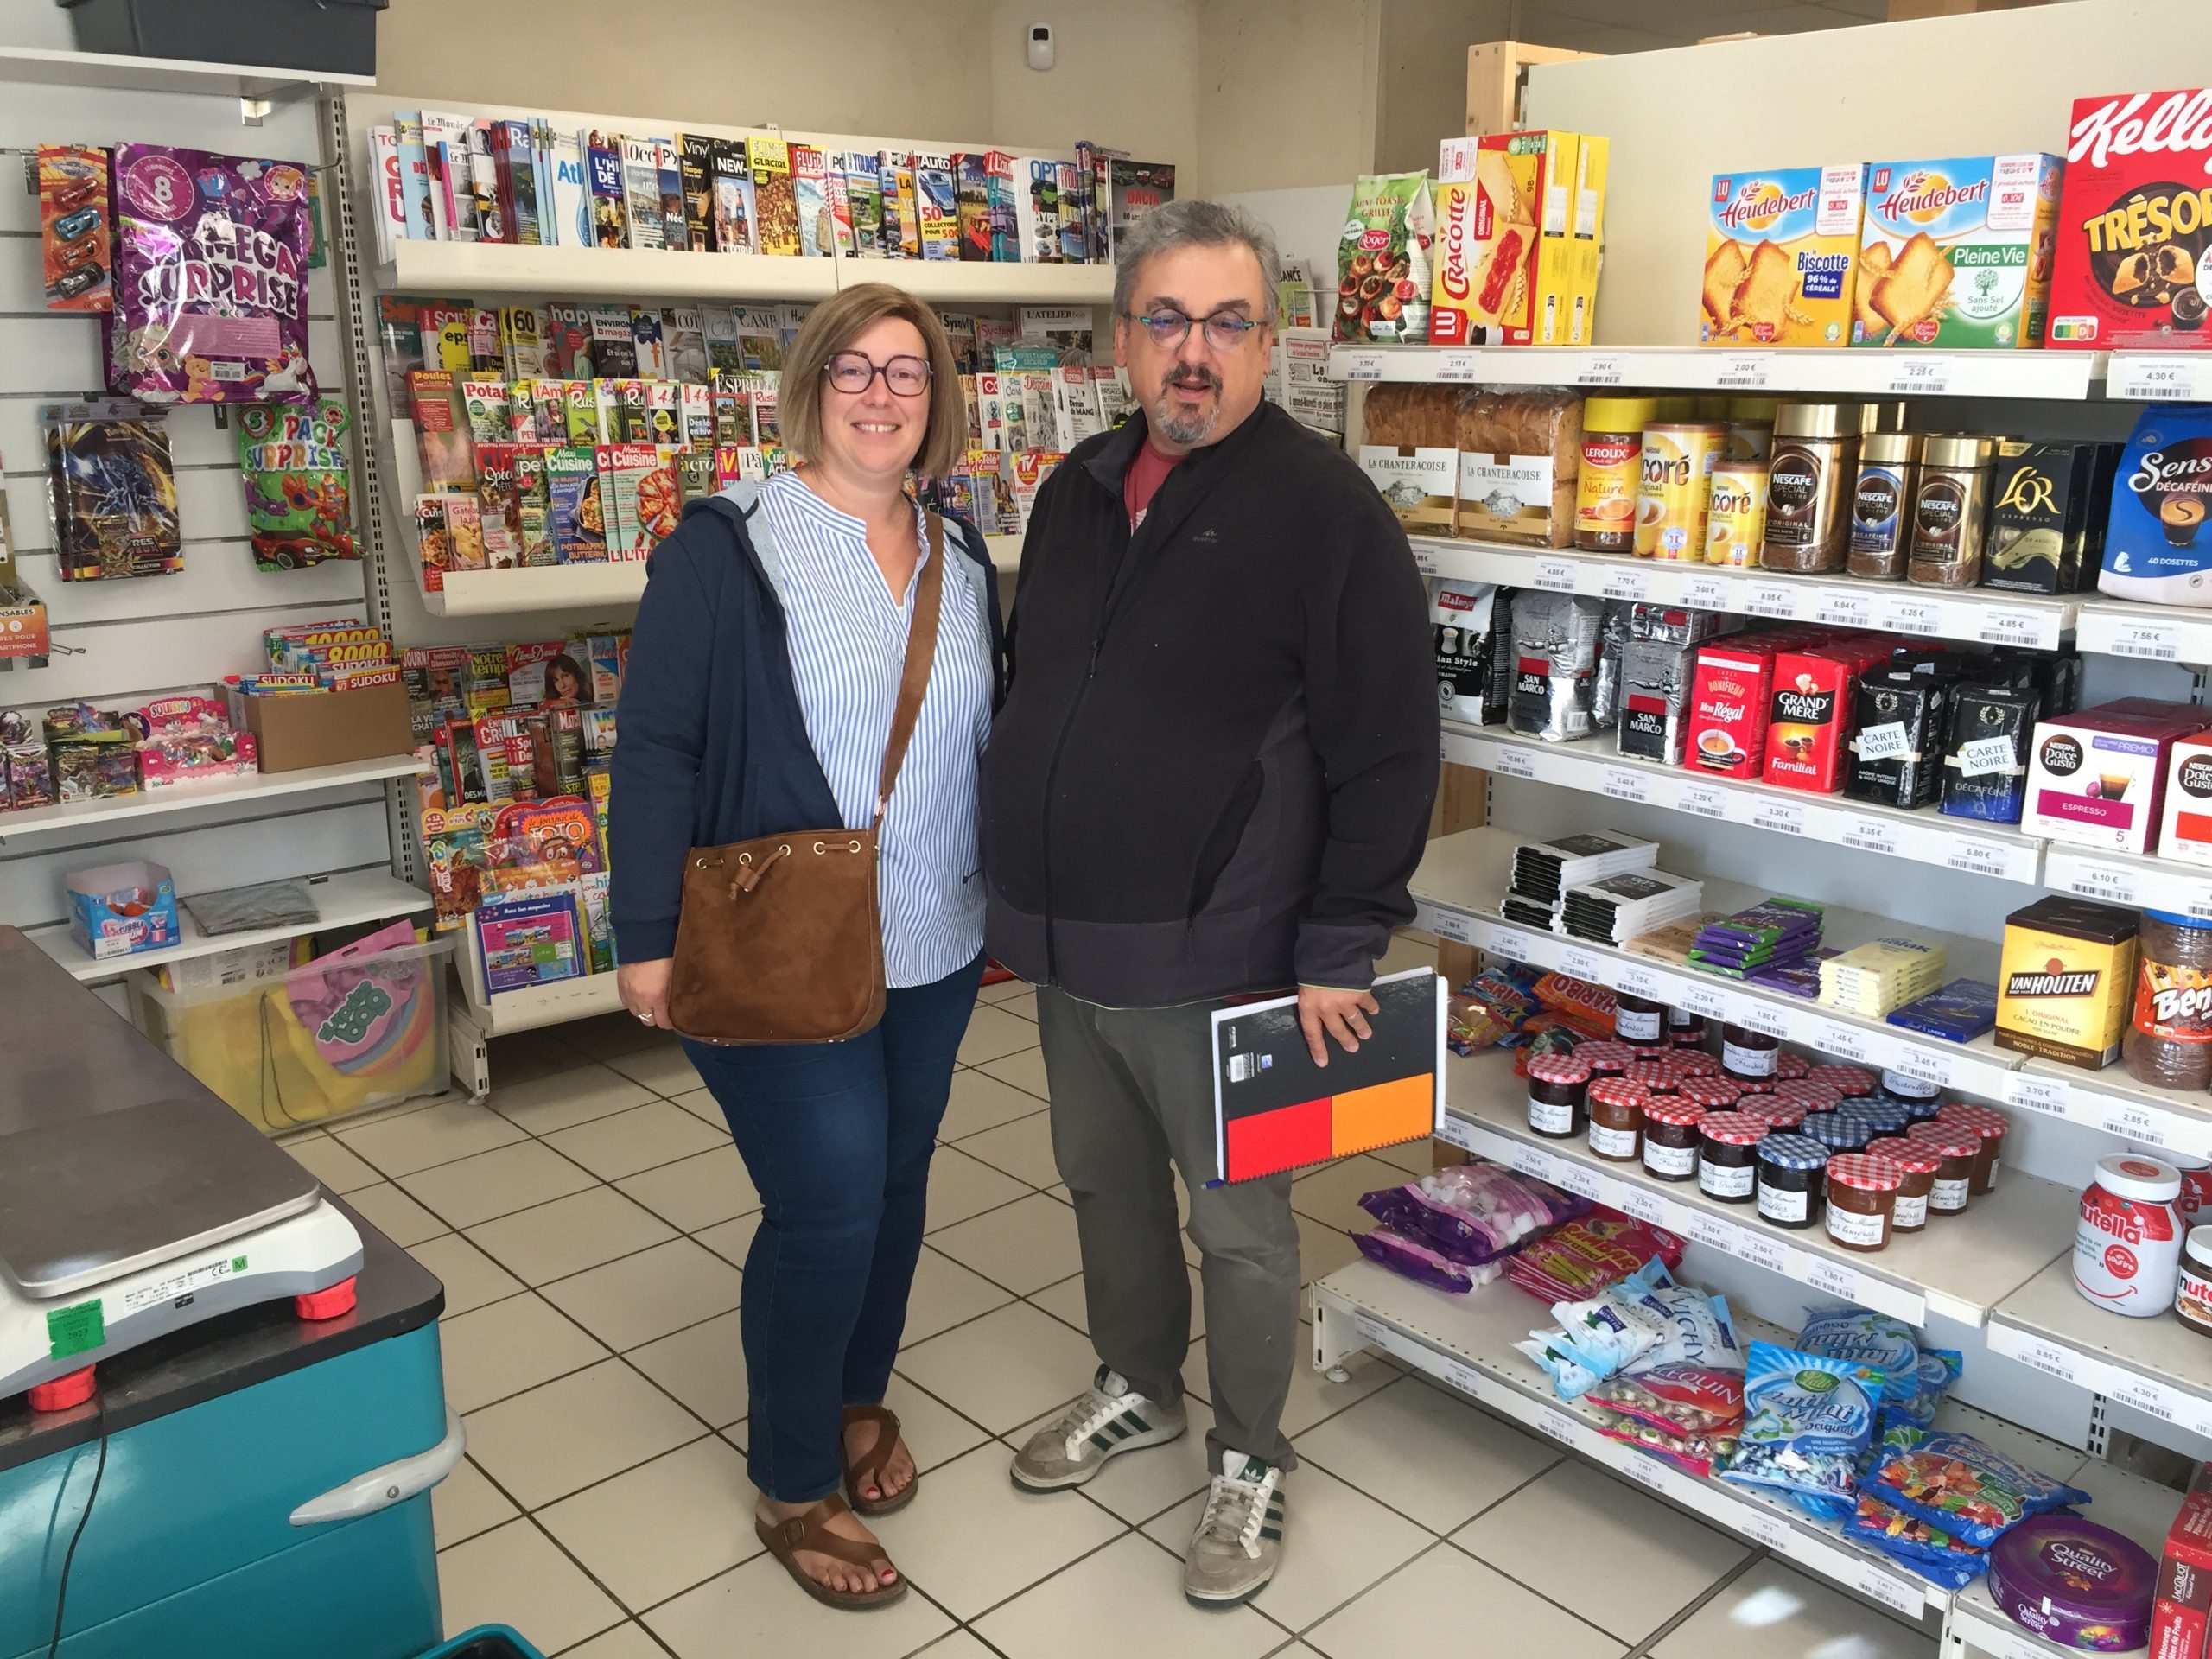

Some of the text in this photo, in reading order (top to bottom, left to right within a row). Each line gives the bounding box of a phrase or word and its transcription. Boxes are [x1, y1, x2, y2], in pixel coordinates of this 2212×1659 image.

[1875, 171, 1889, 188] LU
[154, 176, 173, 201] 8
[1717, 181, 1728, 197] LU
[1877, 181, 1987, 221] Heudebert
[922, 207, 942, 221] 50
[1719, 189, 1815, 228] Heudebert
[1478, 199, 1487, 236] ORIGINAL
[1362, 235, 1389, 249] Roger
[1797, 251, 1848, 271] Biscotte
[1955, 249, 2024, 264] Pleine Vie
[142, 263, 297, 315] SURPRISE
[1971, 304, 1998, 313] ajouté
[514, 310, 535, 332] 60
[1435, 311, 1456, 335] LU
[2146, 372, 2166, 381] 4.30
[249, 412, 261, 429] 5
[557, 449, 576, 459] Maxi
[613, 452, 657, 467] Cuisine
[1586, 448, 1627, 458] LEROUX
[548, 458, 592, 471] Cuisine
[1020, 457, 1035, 472] TV
[1369, 459, 1446, 471] LA CHANTERACOISE
[1477, 467, 1541, 480] CHANTERACOISE
[1773, 473, 1812, 486] NESCAFÉ
[1584, 482, 1624, 493] Nature
[1774, 485, 1808, 493] SPECIAL
[1858, 492, 1893, 503] NESCAFÉ
[1858, 501, 1888, 510] SPECIAL
[1921, 499, 1958, 512] NESCAFÉ
[1922, 509, 1953, 518] SPECIAL
[2160, 558, 2198, 567] DOSETTES
[1901, 608, 1917, 617] 6.25
[1999, 620, 2017, 628] 4.85
[1451, 656, 1478, 668] Style
[352, 672, 395, 688] SUDOKU
[1523, 675, 1539, 685] SAN
[1518, 683, 1544, 696] MARCO
[1637, 712, 1656, 723] SAN
[1714, 702, 1745, 723] Régal
[1630, 721, 1662, 735] MARCO
[1864, 729, 1899, 745] CARTE
[1866, 741, 1904, 754] NOIRE
[1966, 744, 2007, 759] CARTE
[2045, 747, 2077, 761] Dolce
[2118, 741, 2154, 754] PREMIO
[1772, 757, 1816, 775] Familial
[1969, 754, 2008, 769] NOIRE
[2044, 758, 2076, 769] Gusto
[2062, 803, 2107, 817] ESPRESSO
[530, 823, 584, 842] TOTO
[1859, 827, 1875, 836] 5.35
[2116, 831, 2125, 842] 5
[1967, 848, 1982, 857] 5.80
[2012, 974, 2095, 995] VAN HOUTEN
[1551, 975, 1617, 1014] HARIBO
[2014, 1014, 2037, 1026] CACAO
[2051, 1022, 2080, 1035] POUDRE
[2013, 1040, 2075, 1060] NOBLE TRADITION
[2026, 1085, 2050, 1097] 3.70 €
[2124, 1113, 2149, 1126] 2.85 €
[2133, 1387, 2158, 1400] 4.30 €
[2050, 1542, 2117, 1573] Quality
[2051, 1553, 2105, 1580] Street
[2018, 1603, 2048, 1626] Quality
[2019, 1612, 2044, 1632] Street
